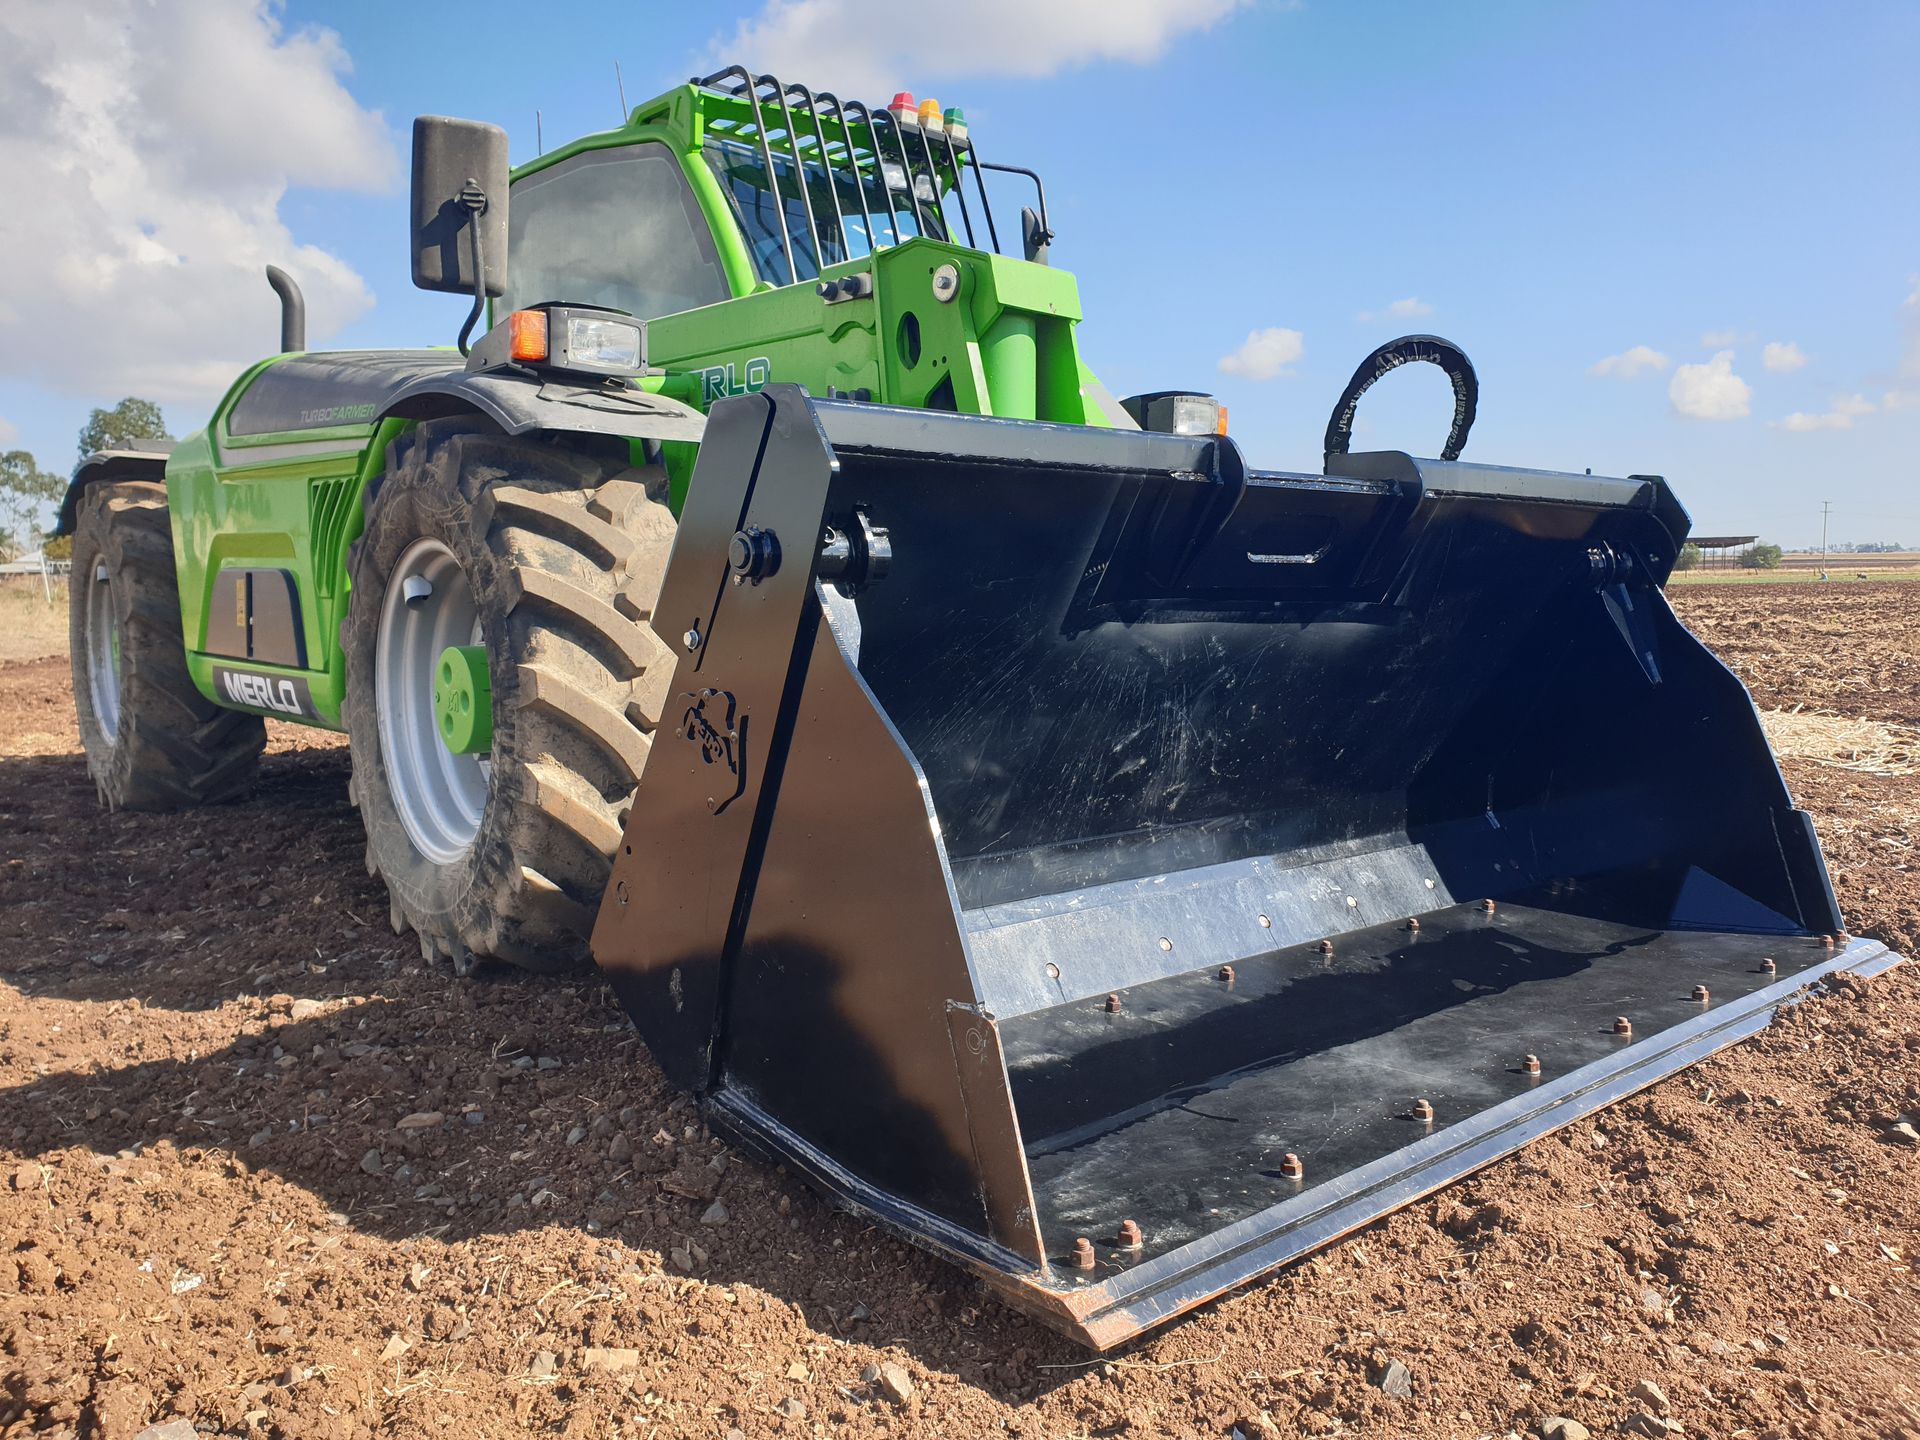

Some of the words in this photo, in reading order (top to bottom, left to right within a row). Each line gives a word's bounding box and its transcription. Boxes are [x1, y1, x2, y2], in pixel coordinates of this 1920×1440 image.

[698, 356, 770, 405] RLO
[300, 403, 376, 423] TURBOFARMER
[223, 671, 303, 715] MERLO
